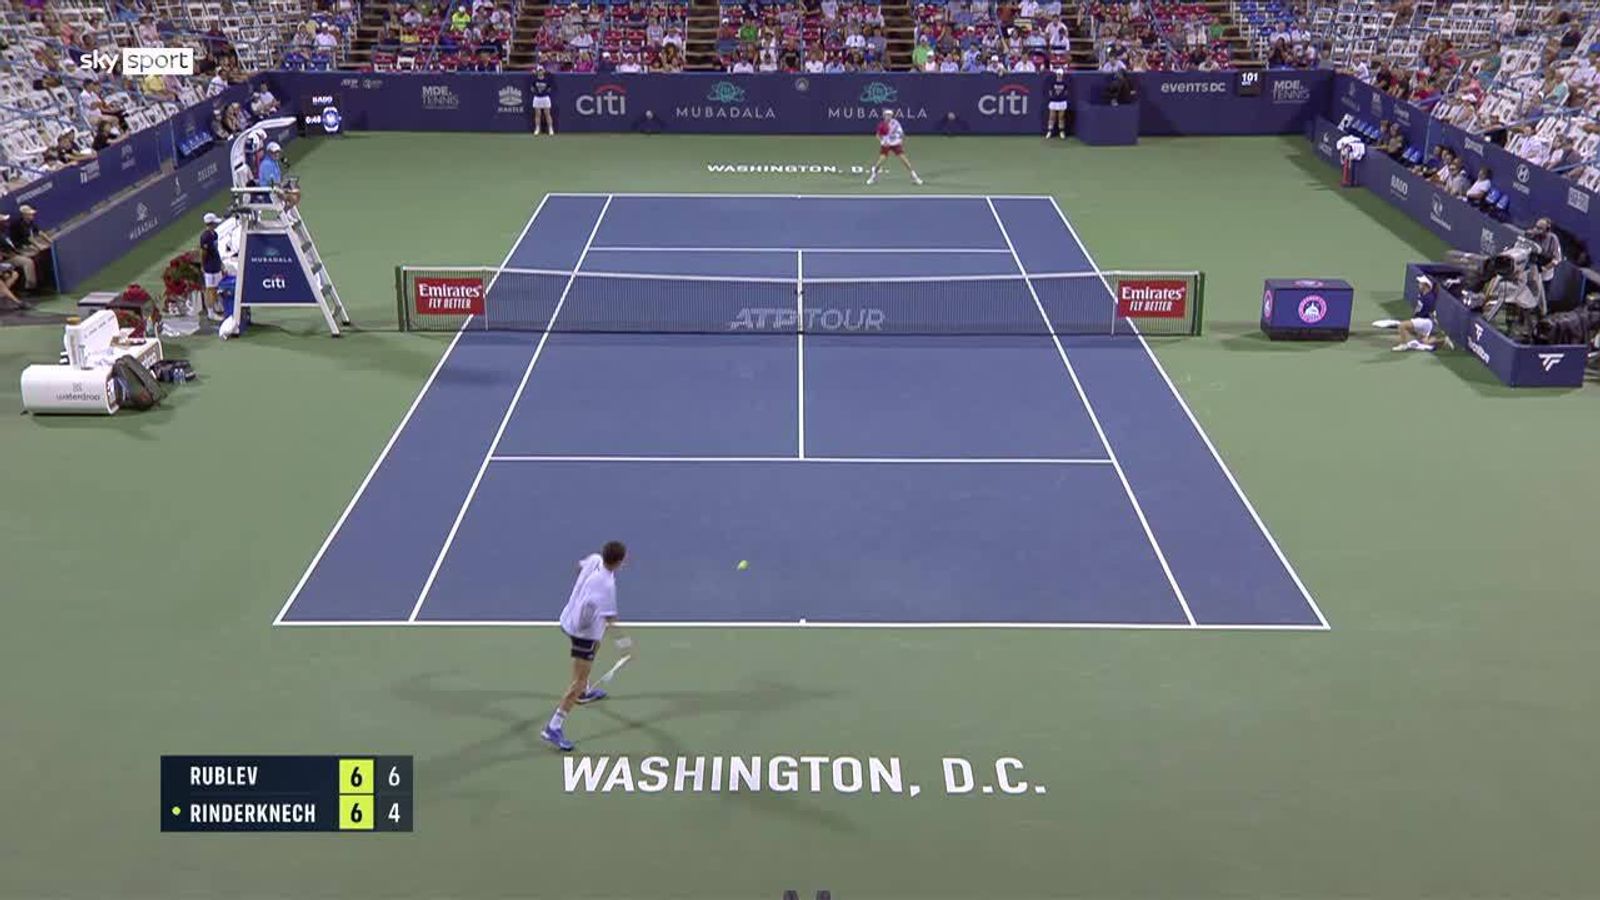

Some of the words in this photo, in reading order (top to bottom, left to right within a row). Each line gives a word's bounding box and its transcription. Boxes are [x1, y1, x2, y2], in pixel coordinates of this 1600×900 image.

[1241, 72, 1258, 82] 101
[575, 90, 626, 116] citi
[977, 90, 1029, 115] citi
[675, 106, 776, 118] MUBADALA
[828, 107, 928, 119] MUBAALA
[262, 277, 286, 289] citi
[418, 283, 482, 298] Emirates
[1121, 286, 1186, 300] Emirates
[428, 298, 442, 309] FLY
[443, 298, 472, 309] BETTER
[1129, 300, 1143, 311] FLY
[1144, 300, 1173, 311] BETTER
[561, 756, 921, 798] WASHINGTON,
[941, 757, 1048, 794] D.C.
